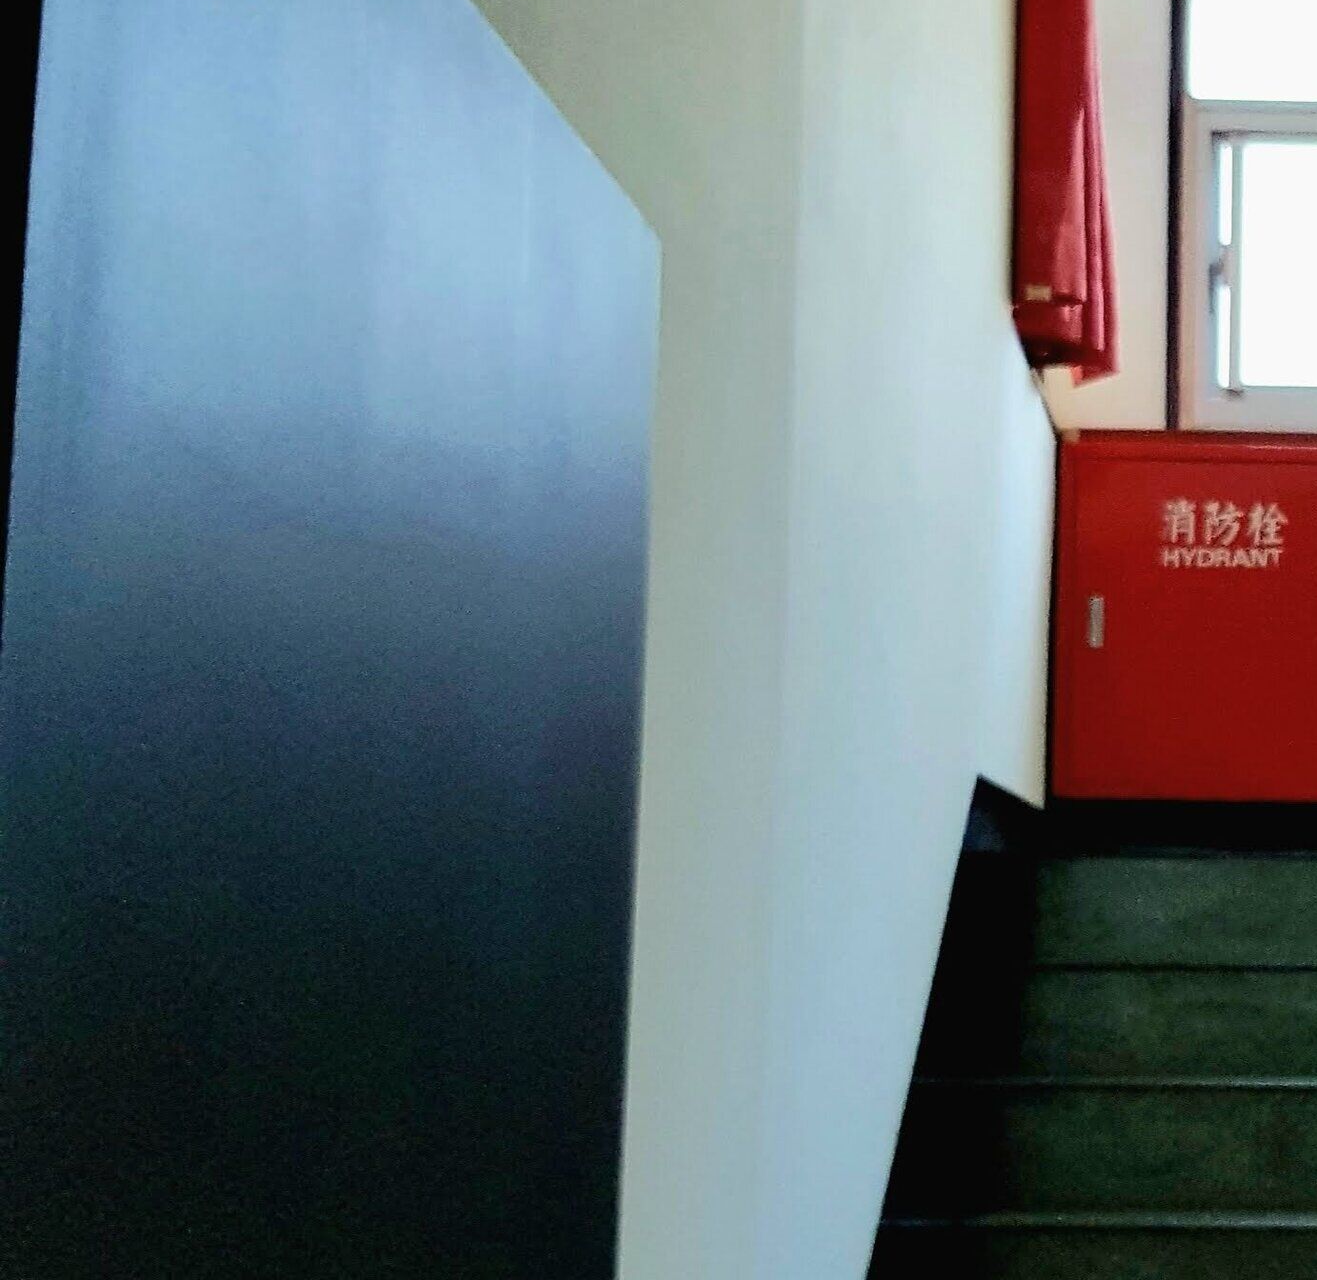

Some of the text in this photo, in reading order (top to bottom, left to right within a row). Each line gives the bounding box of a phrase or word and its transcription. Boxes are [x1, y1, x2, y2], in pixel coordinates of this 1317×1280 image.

[1162, 498, 1288, 546] 消防栓
[1161, 546, 1283, 568] HYDRANT
